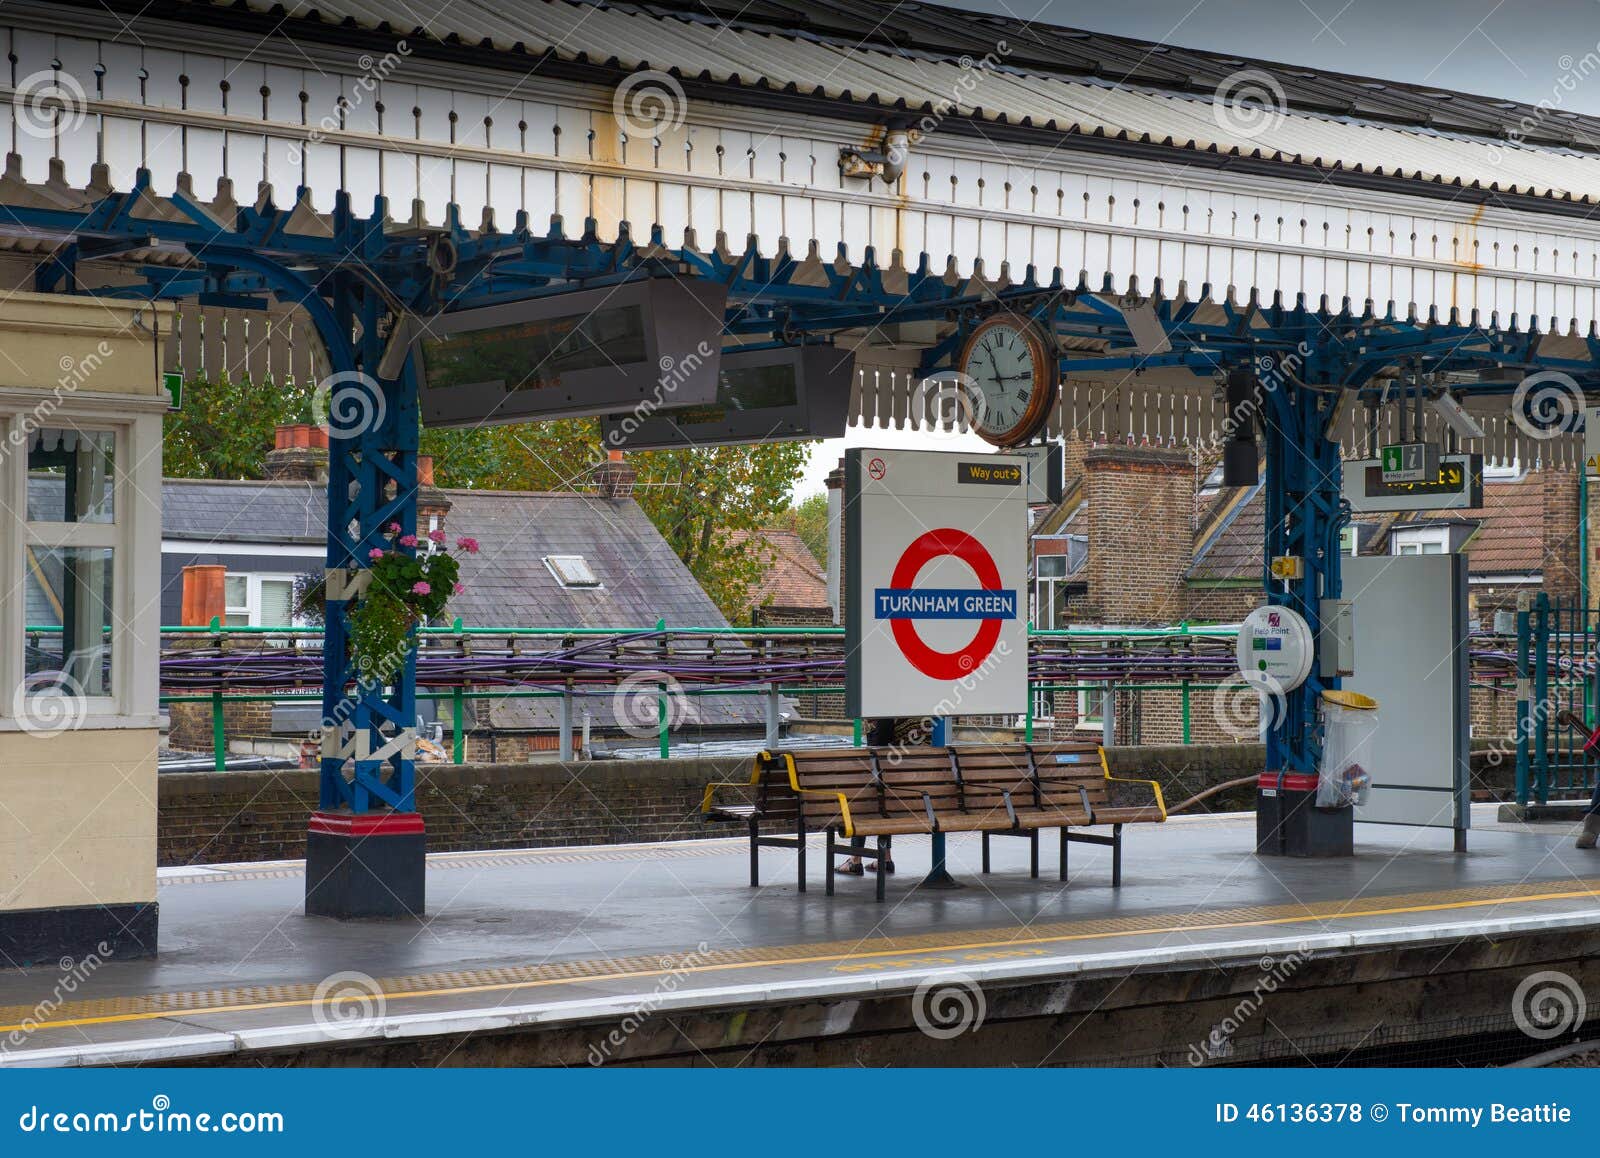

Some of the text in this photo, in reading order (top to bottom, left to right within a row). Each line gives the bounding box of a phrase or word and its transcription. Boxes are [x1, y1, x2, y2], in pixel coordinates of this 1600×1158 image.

[970, 466, 1009, 480] Way out
[880, 595, 1013, 612] TURNHAM GREEN
[1271, 627, 1289, 635] Point
